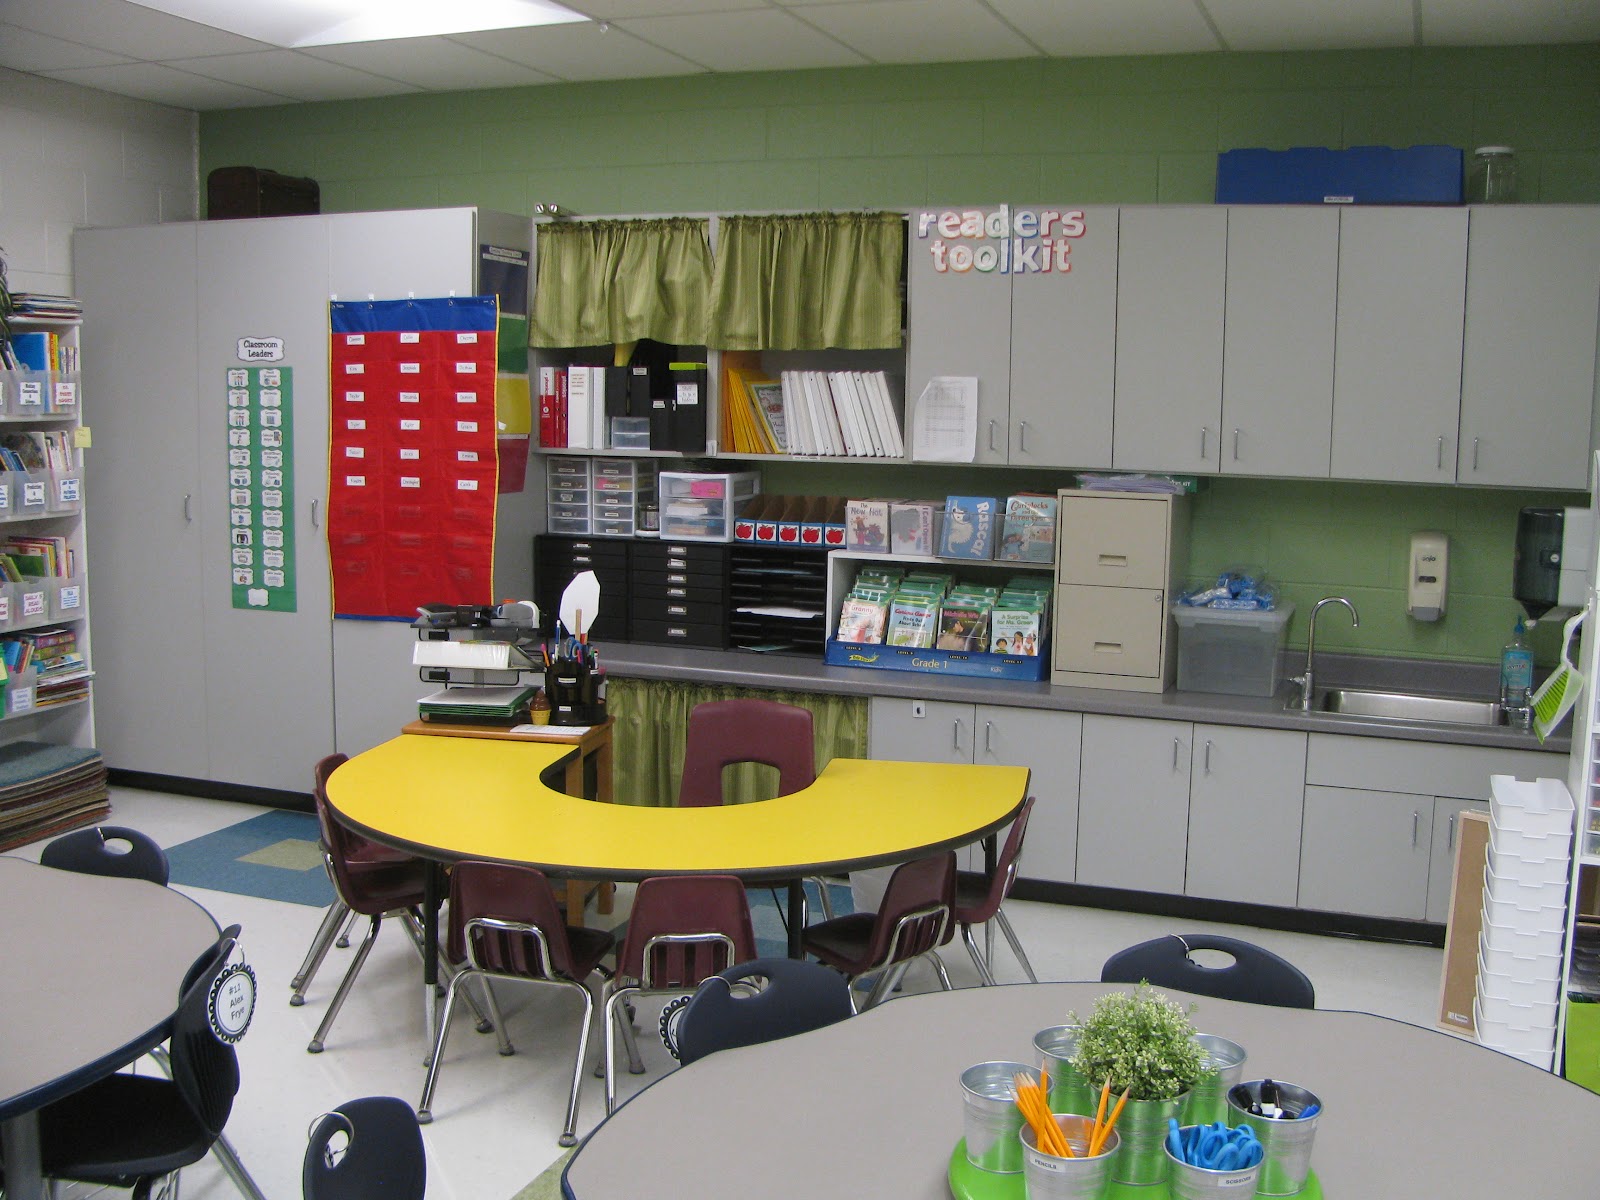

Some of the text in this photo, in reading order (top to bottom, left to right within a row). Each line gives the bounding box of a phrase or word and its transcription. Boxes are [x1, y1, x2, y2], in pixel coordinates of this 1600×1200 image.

[918, 203, 1087, 240] readers
[930, 237, 1073, 275] toolkit
[243, 340, 278, 349] Classroom
[248, 349, 274, 358] Leaders
[851, 507, 882, 517] New Hat
[970, 501, 990, 557] Rascal
[851, 605, 873, 614] Granny
[911, 657, 948, 669] Grade 1
[230, 995, 243, 1007] Alex
[231, 1007, 244, 1020] Frye
[1034, 1158, 1057, 1170] PENCILS
[1225, 1175, 1252, 1185] SCISSORS
